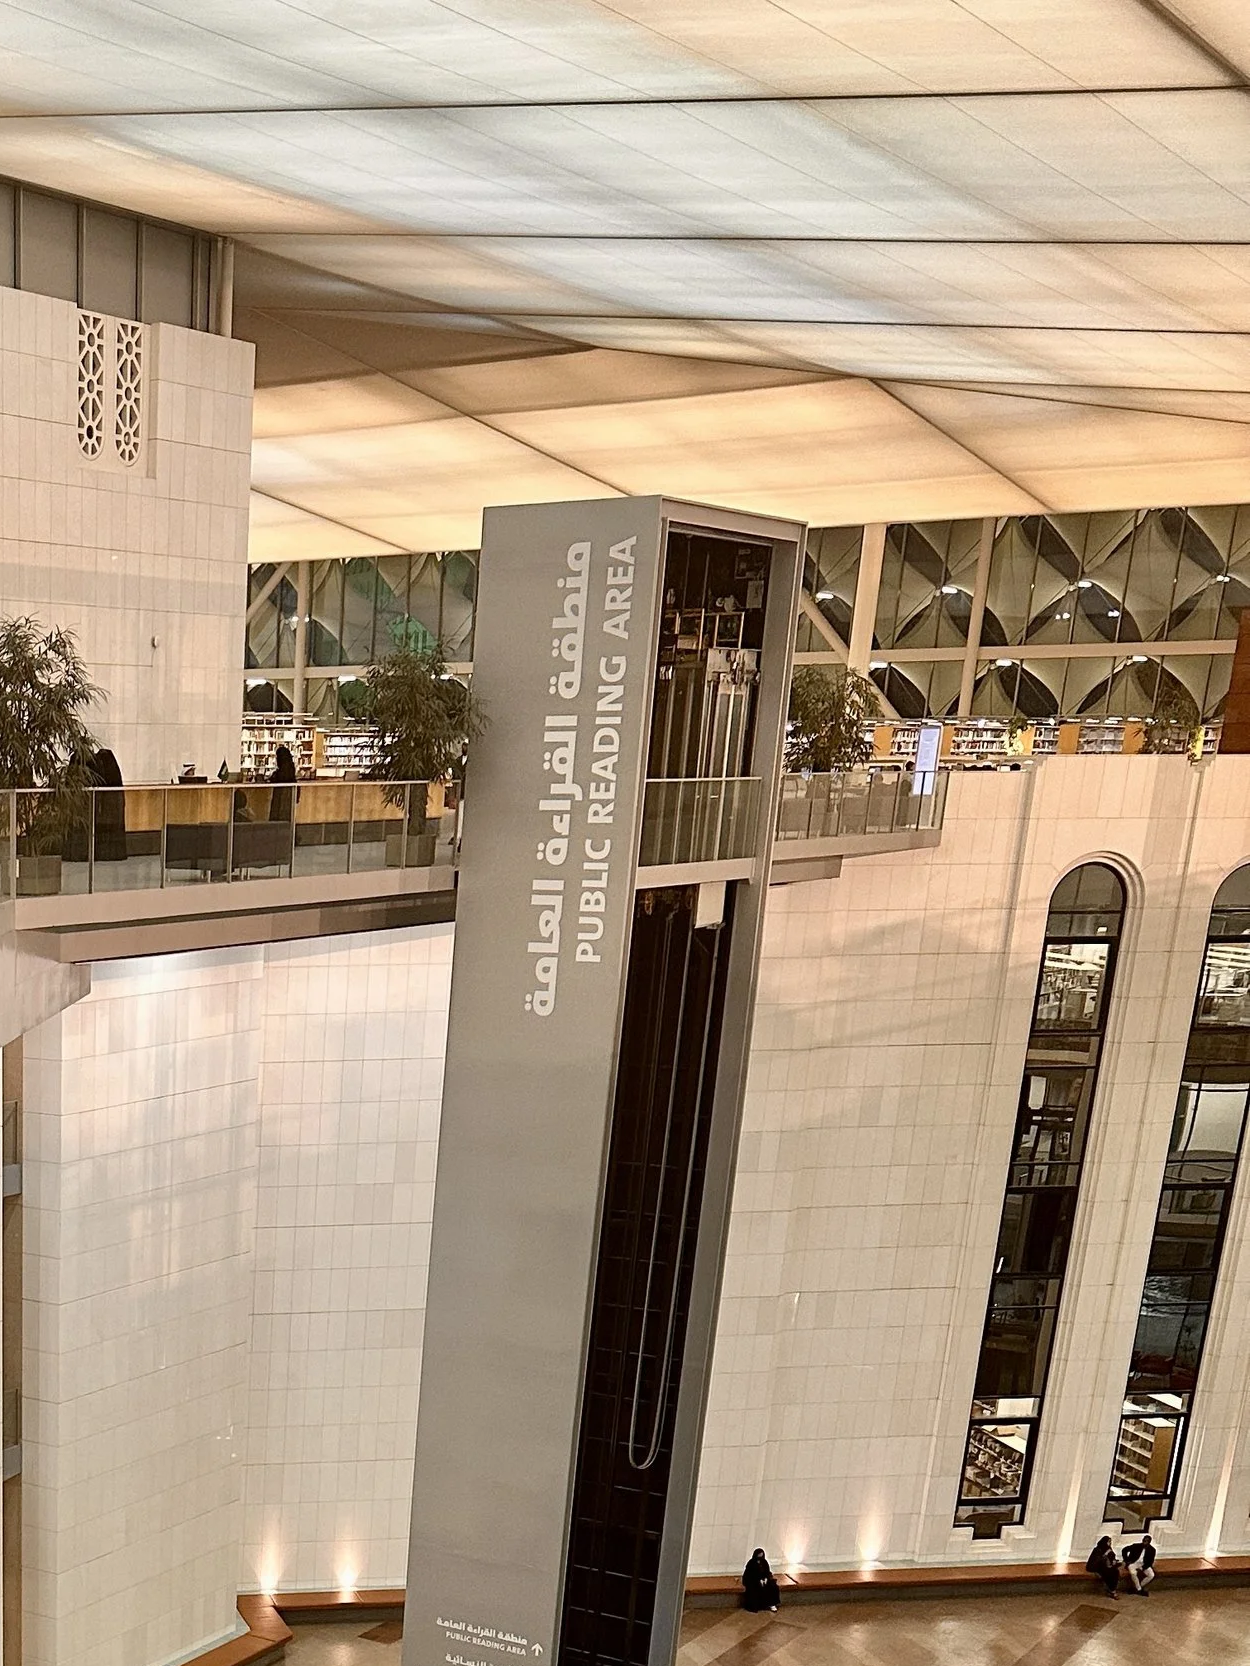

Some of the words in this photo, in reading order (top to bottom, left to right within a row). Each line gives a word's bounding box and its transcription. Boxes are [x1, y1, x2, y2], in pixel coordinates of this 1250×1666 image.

[549, 541, 592, 699] منطقة
[602, 535, 639, 640] AREA
[537, 715, 583, 866] القراءة
[587, 654, 628, 824] READING
[524, 879, 565, 1017] العامة
[576, 838, 612, 963] PUBLIC
[436, 1616, 466, 1631] العامة
[446, 1631, 471, 1643] PUBLIC
[472, 1638, 505, 1651] READING
[506, 1644, 526, 1656] AREA
[467, 1624, 496, 1638] القراءة
[498, 1631, 528, 1645] منطقة
